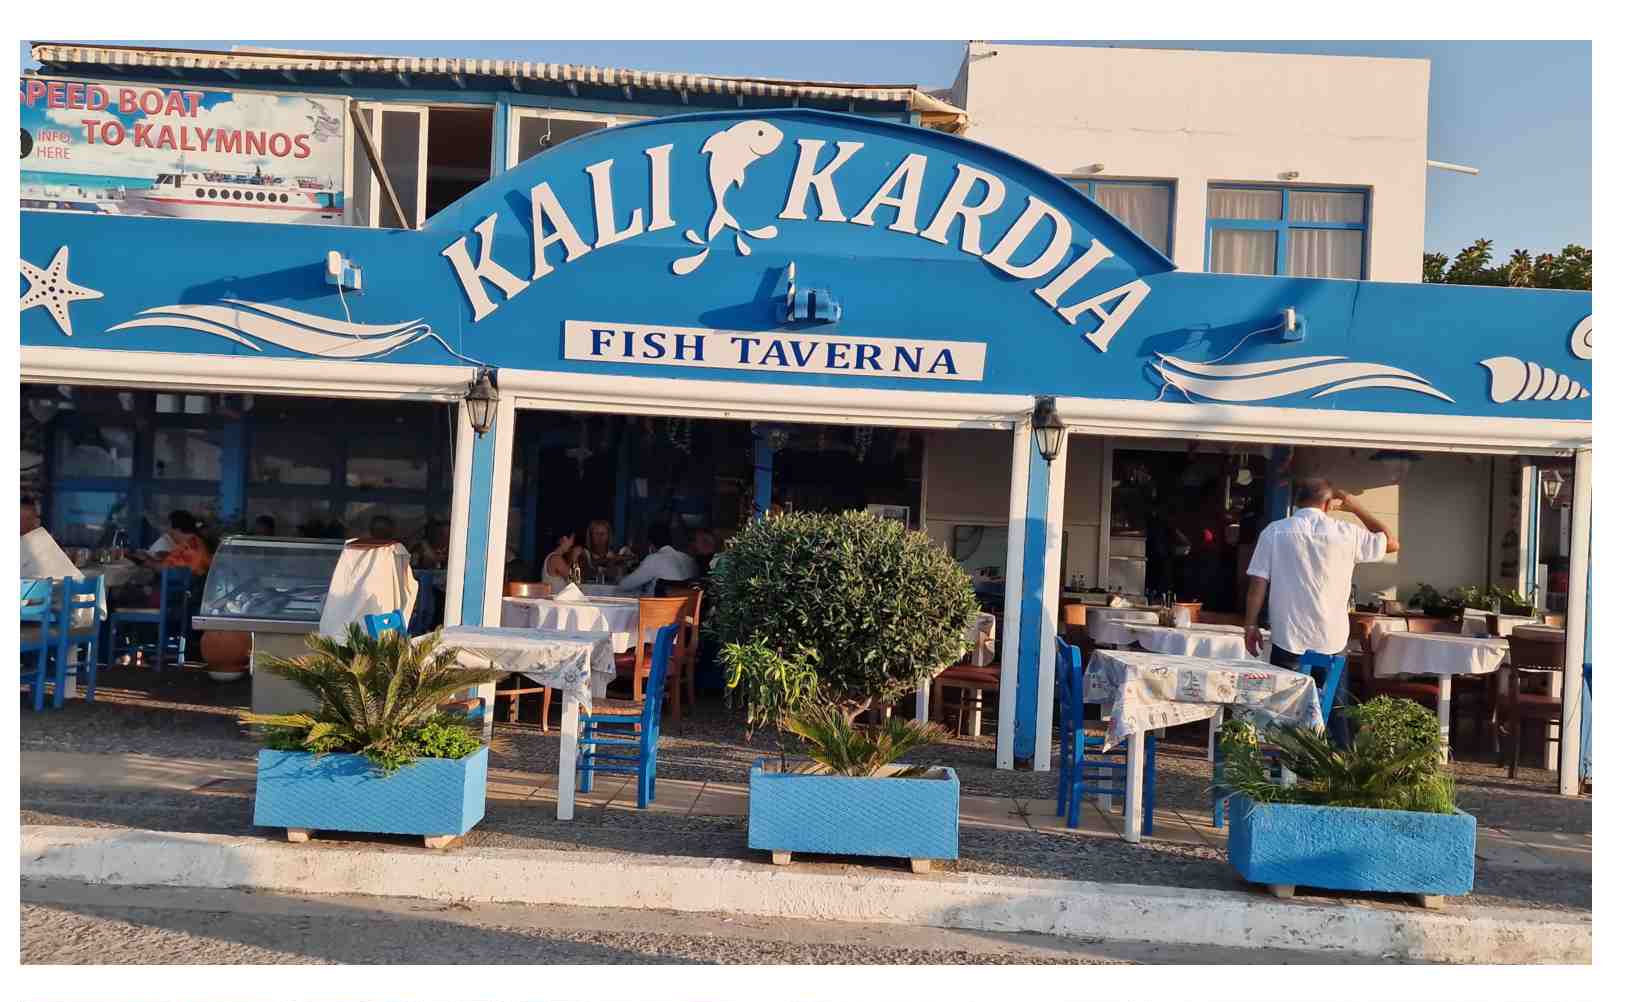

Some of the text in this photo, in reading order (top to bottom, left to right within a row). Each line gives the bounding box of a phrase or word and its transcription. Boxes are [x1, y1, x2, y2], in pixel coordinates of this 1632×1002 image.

[119, 88, 204, 118] BOAT
[37, 146, 72, 160] HERE
[81, 119, 311, 159] TO KALYMNOS
[441, 138, 1152, 354] KALI KARDIA
[590, 328, 960, 375] FISH TAVERNA
